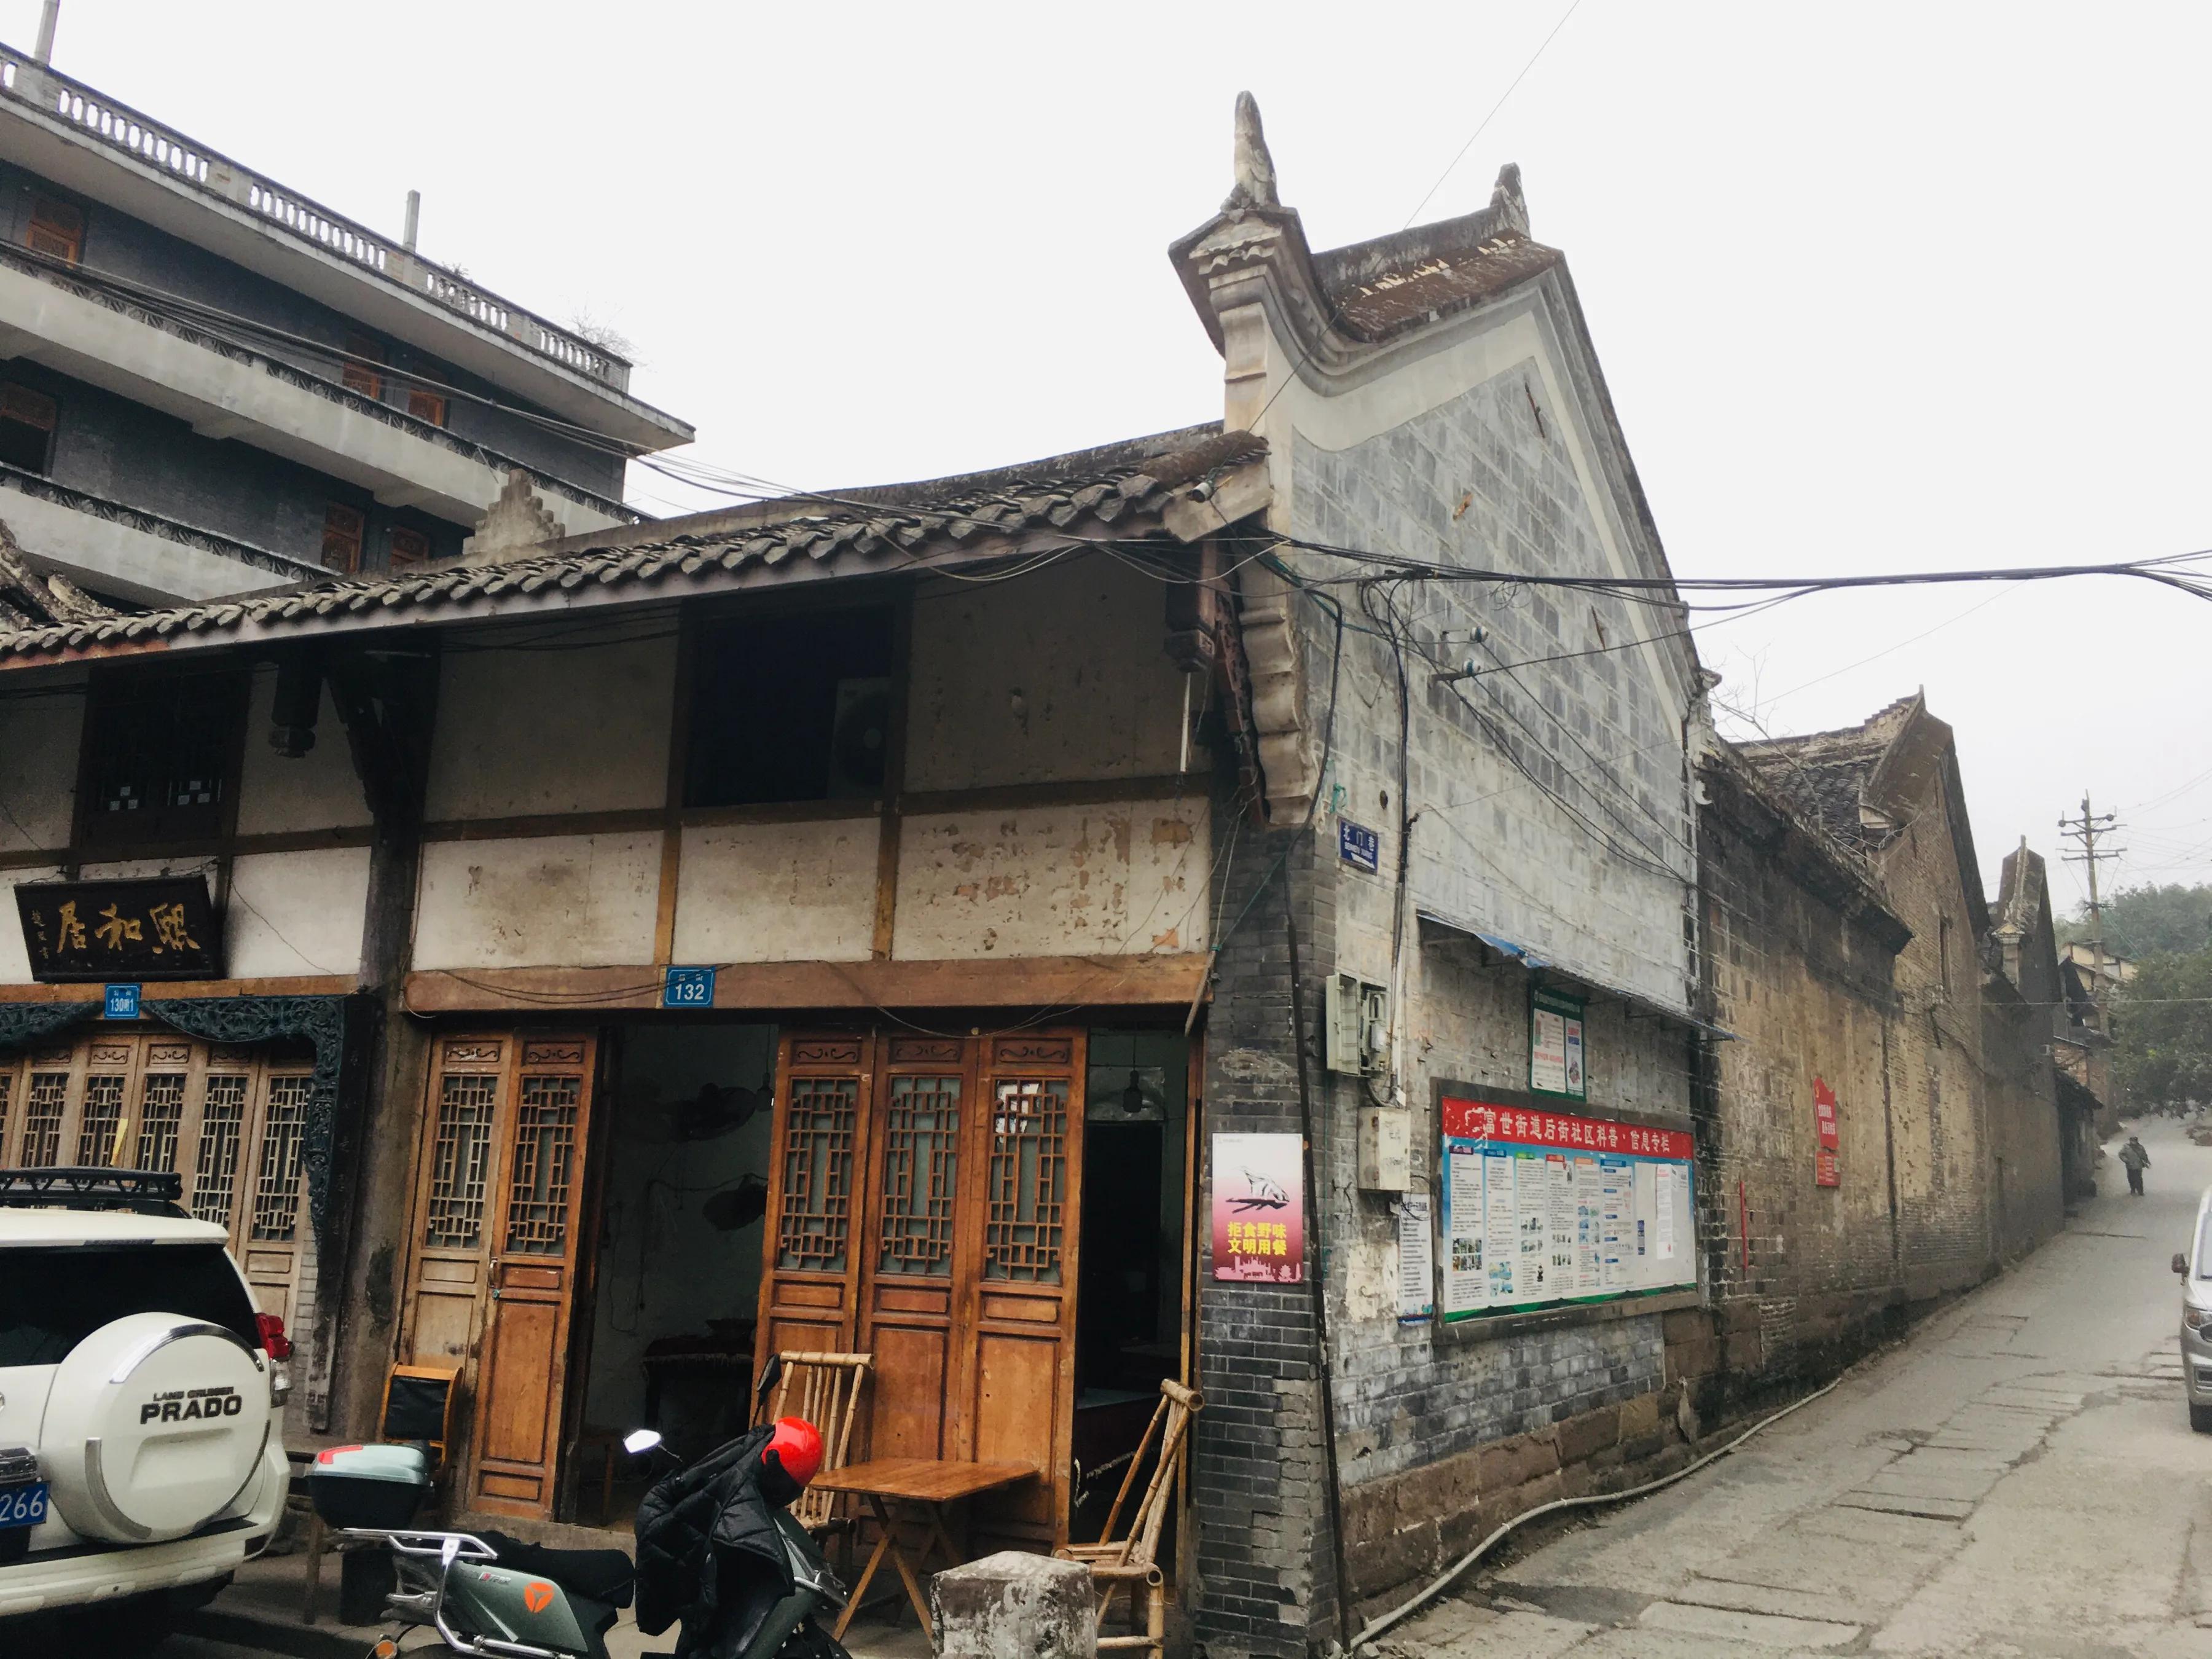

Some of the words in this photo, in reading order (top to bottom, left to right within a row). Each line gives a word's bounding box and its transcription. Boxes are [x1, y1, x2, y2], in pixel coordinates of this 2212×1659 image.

[675, 984, 704, 1000] 132
[1228, 1222, 1287, 1239] 拒食野味
[1228, 1238, 1287, 1256] 文明用餐
[153, 1390, 184, 1402] LAND
[140, 1395, 242, 1424] PRADO
[0, 1490, 43, 1521] 266
